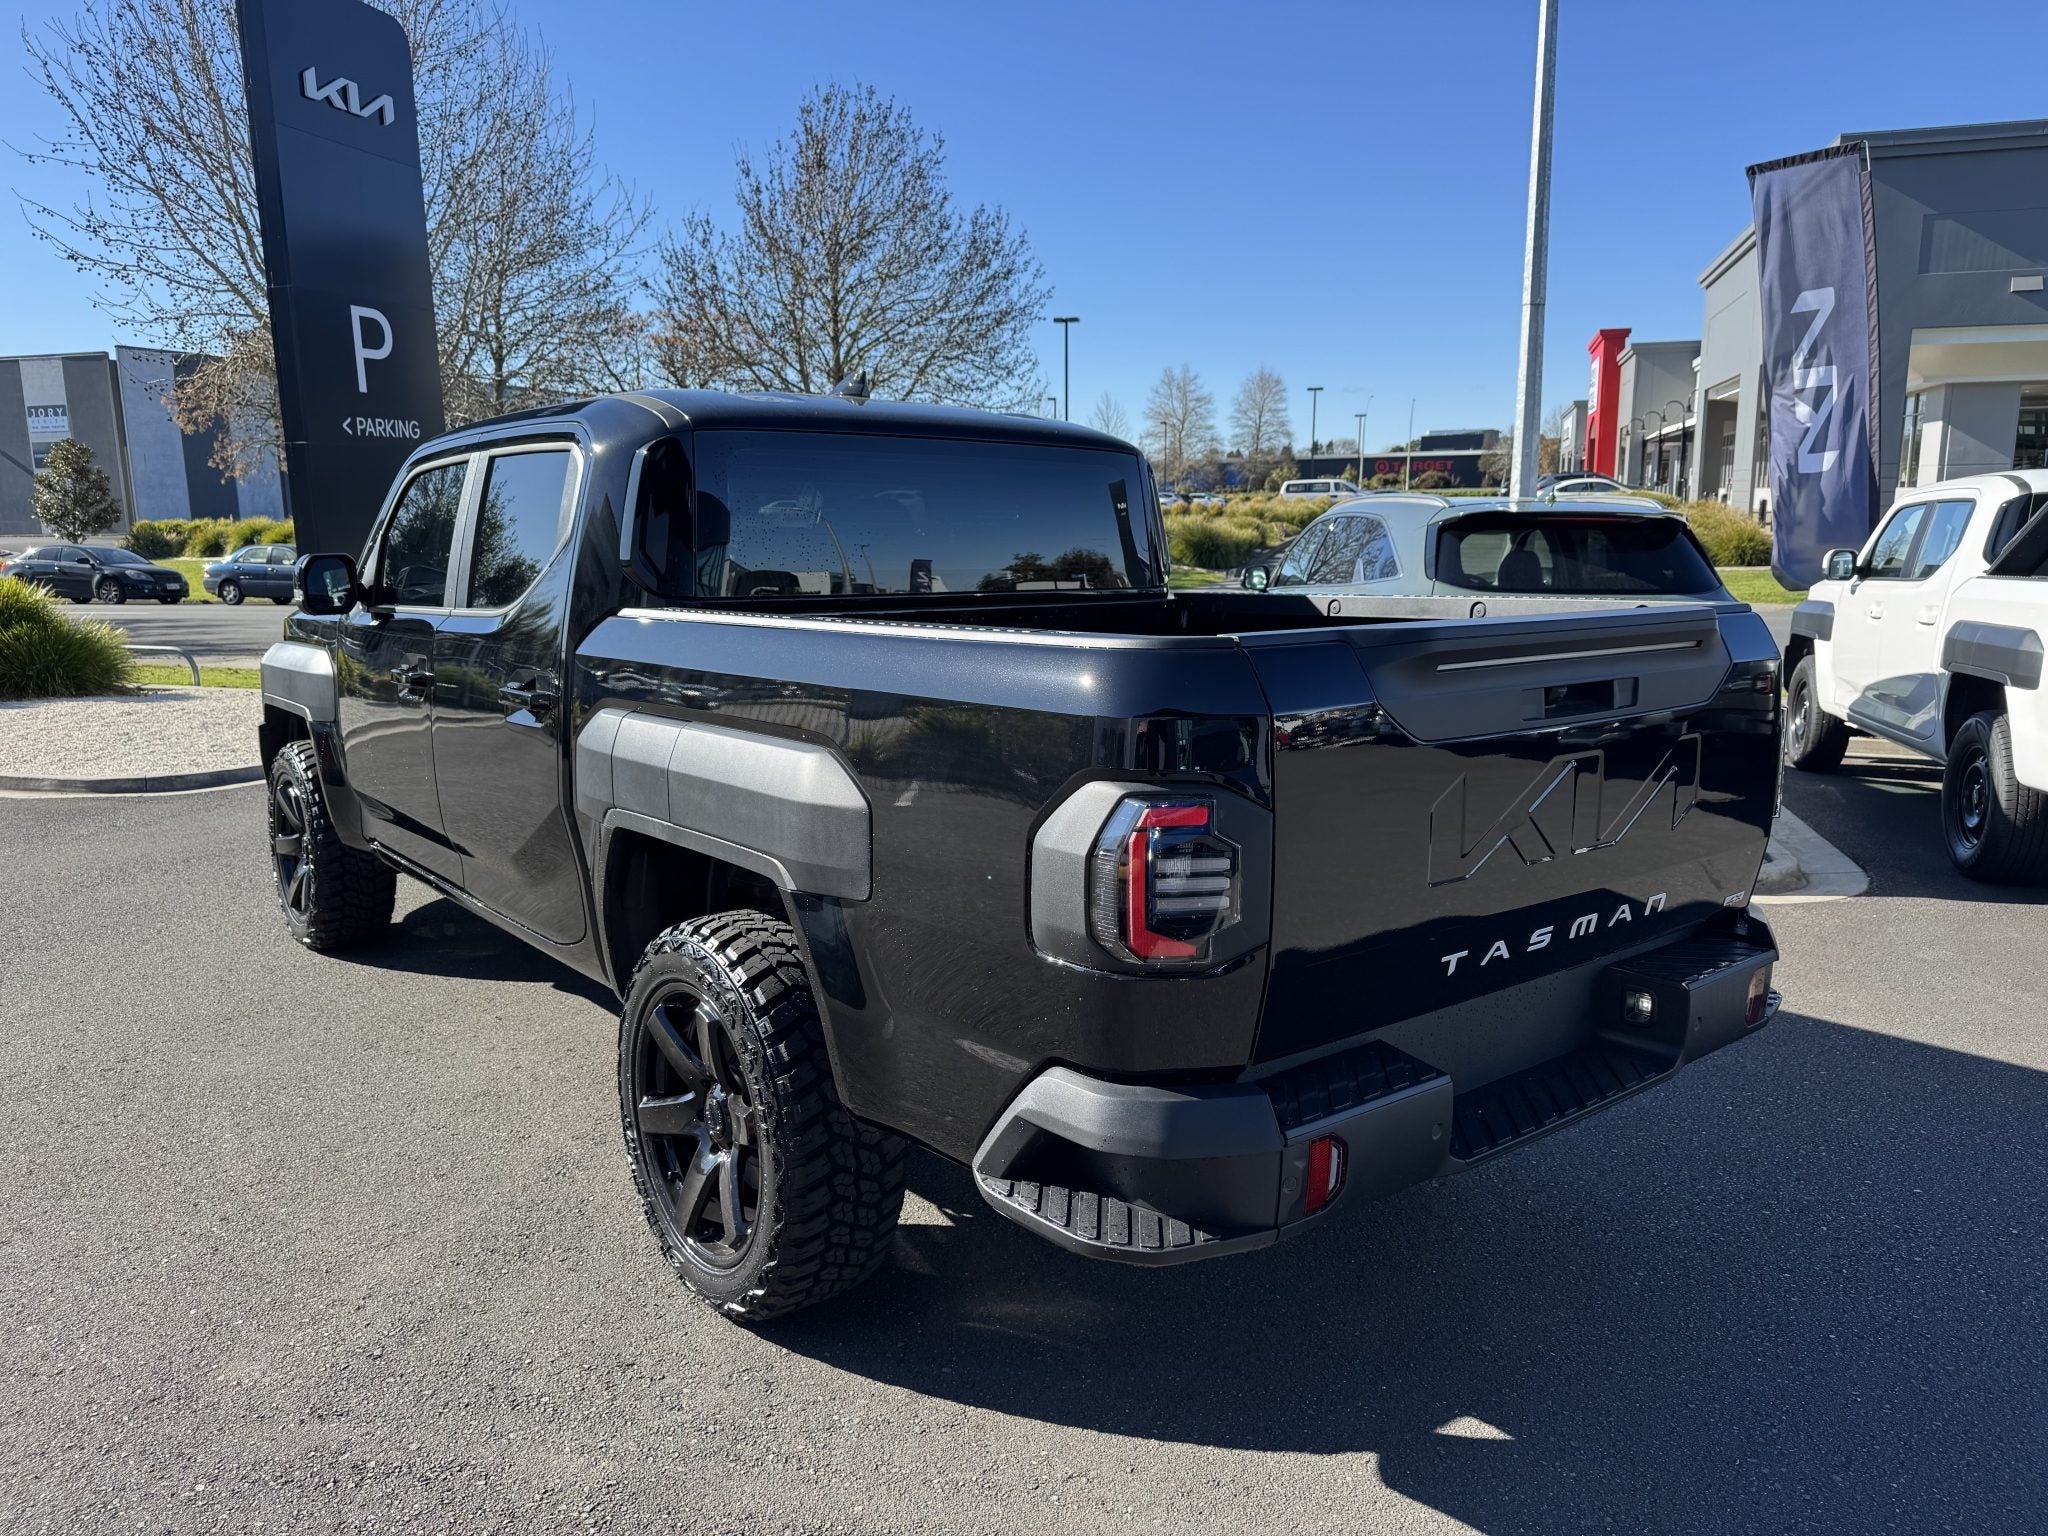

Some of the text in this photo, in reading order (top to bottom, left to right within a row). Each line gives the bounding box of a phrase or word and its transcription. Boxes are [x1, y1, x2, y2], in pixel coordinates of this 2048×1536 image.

[301, 66, 395, 126] KIA
[350, 304, 393, 394] P
[30, 407, 64, 418] JORY
[356, 416, 420, 440] PARKING
[1392, 460, 1455, 471] TRGET
[1427, 731, 1702, 888] KIA
[1441, 892, 1667, 976] TASMAN
